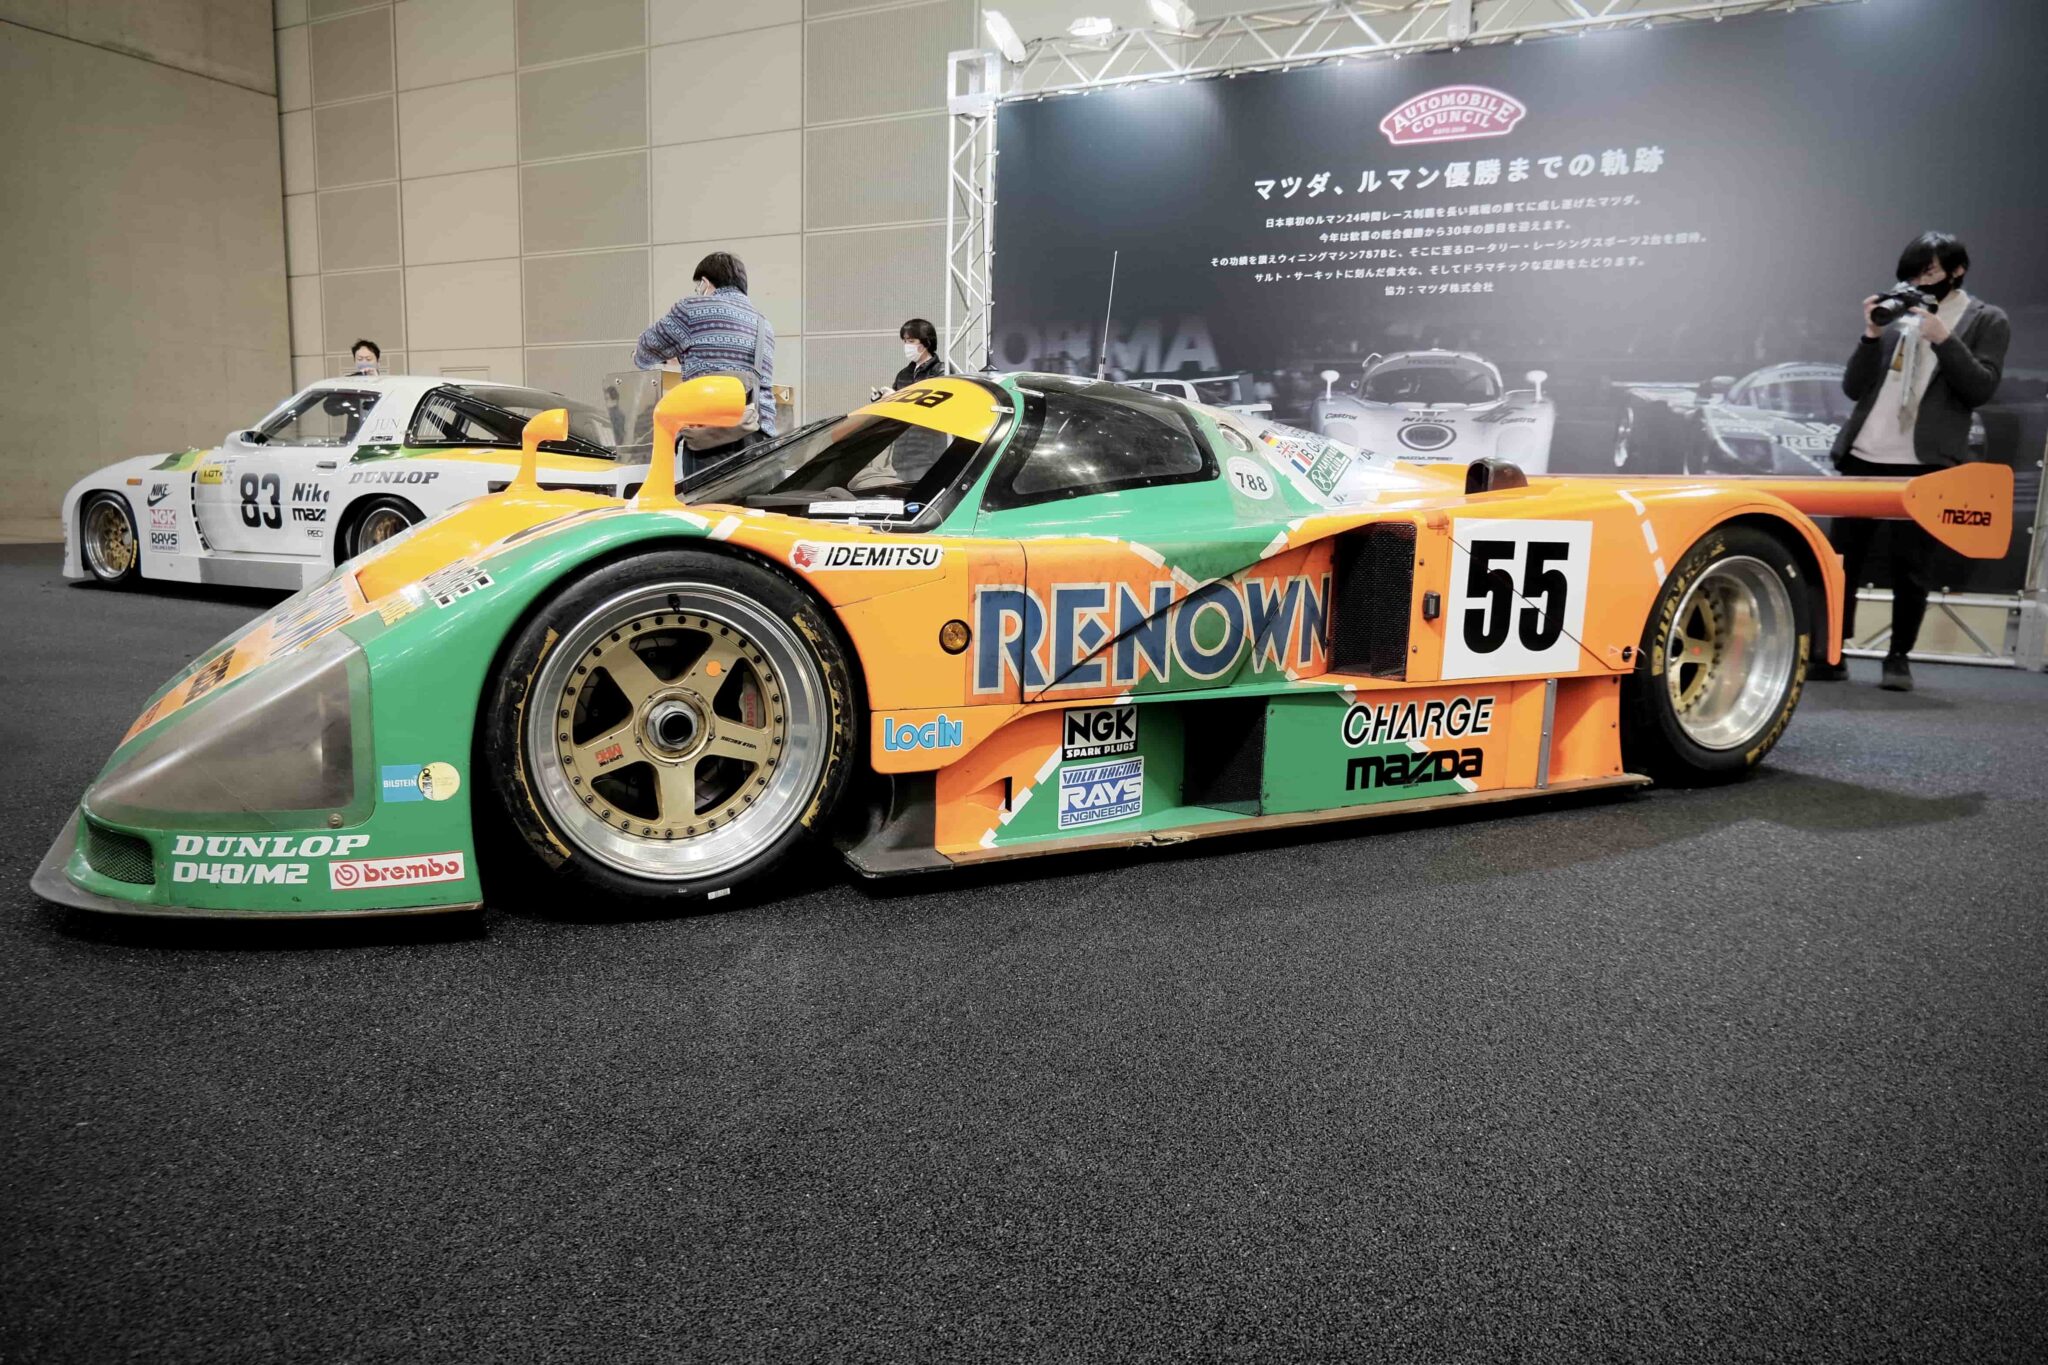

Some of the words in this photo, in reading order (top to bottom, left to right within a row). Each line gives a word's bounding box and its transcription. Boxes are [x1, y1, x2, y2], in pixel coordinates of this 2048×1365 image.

[1393, 92, 1515, 134] AUTOMOBILE
[1412, 110, 1491, 134] COUNCIL
[1254, 145, 1665, 201] マツダ、ルマン優勝までの軌跡
[350, 471, 439, 484] DUNLOP
[1236, 472, 1268, 492] 788
[150, 484, 169, 496] NIKE
[240, 472, 283, 529] 83
[1942, 508, 1992, 527] mazda
[151, 532, 178, 545] RAYS
[824, 546, 939, 567] IDEMITSU
[1463, 539, 1570, 654] 55
[972, 572, 1332, 695] RENOWN
[1067, 707, 1136, 745] NGK
[1342, 696, 1495, 747] CHARGE
[1066, 746, 1102, 759] SPARK
[1104, 741, 1135, 754] PLUGS
[1346, 747, 1483, 791] mazda
[383, 779, 418, 788] BILSTEIN
[1061, 777, 1142, 811] RAYS
[1061, 801, 1141, 824] ENGINEERING
[171, 834, 370, 858] DUNLOP
[172, 861, 310, 885] D40/M2
[363, 857, 460, 883] brembo
